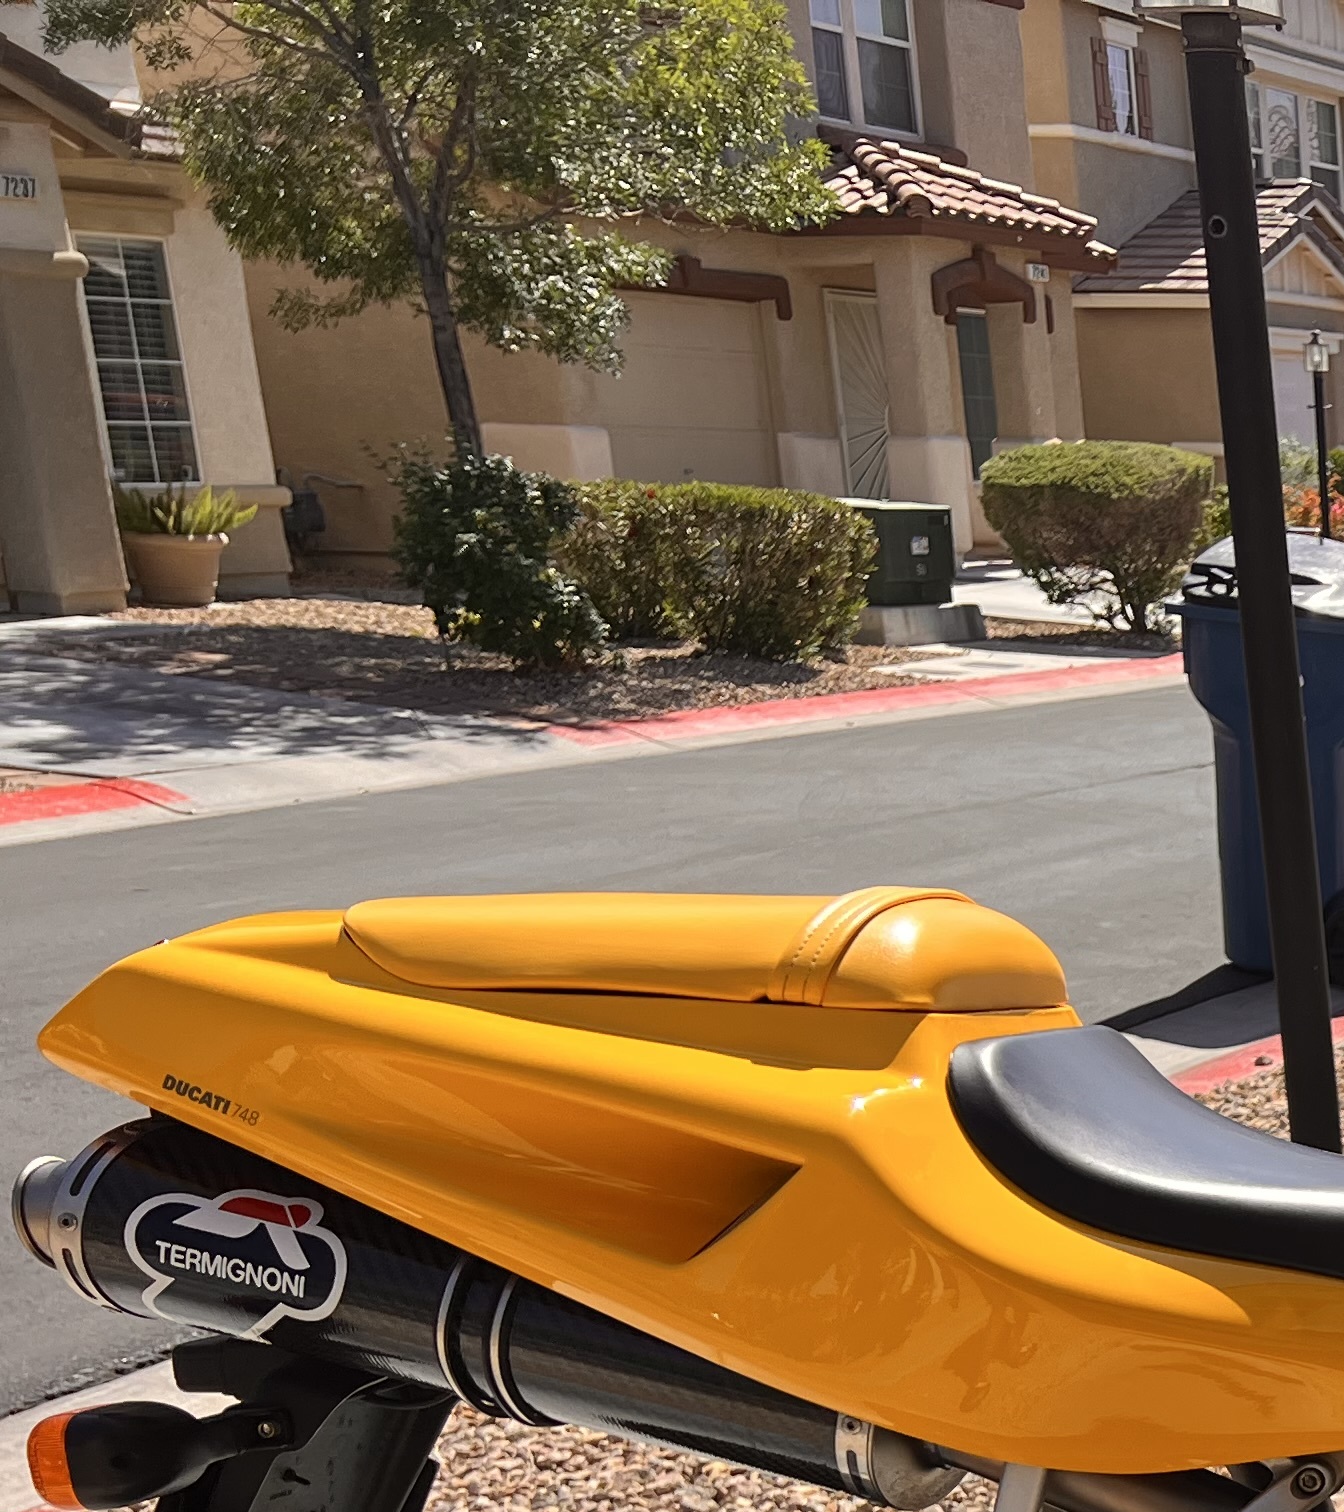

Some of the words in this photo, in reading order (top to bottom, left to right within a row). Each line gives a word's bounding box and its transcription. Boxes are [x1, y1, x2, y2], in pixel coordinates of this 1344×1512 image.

[162, 1073, 232, 1115] DUCATI
[231, 1103, 261, 1127] 748
[155, 1240, 306, 1298] TERMIGNONI
